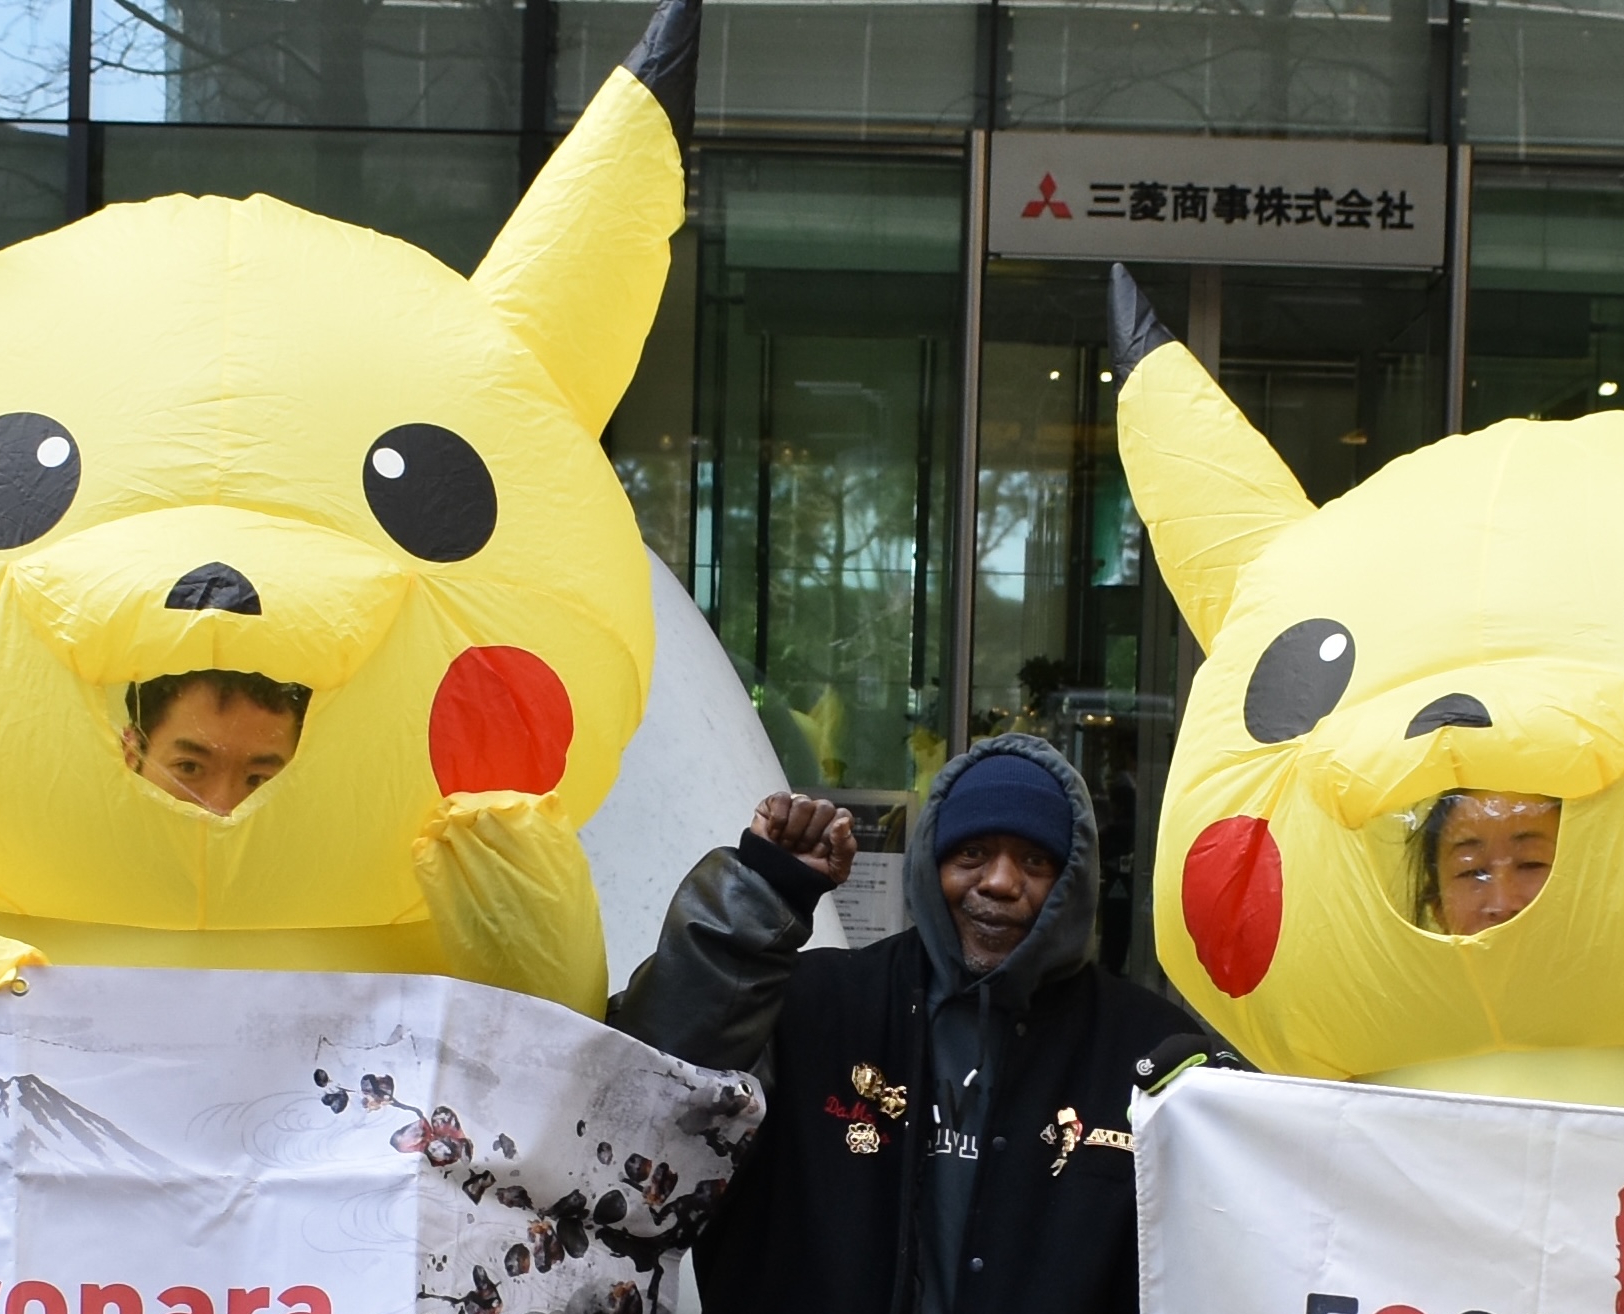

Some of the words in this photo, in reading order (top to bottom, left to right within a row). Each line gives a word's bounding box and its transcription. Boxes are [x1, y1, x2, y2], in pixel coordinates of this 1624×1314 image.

[1086, 180, 1416, 231] 三菱商事株式会社
